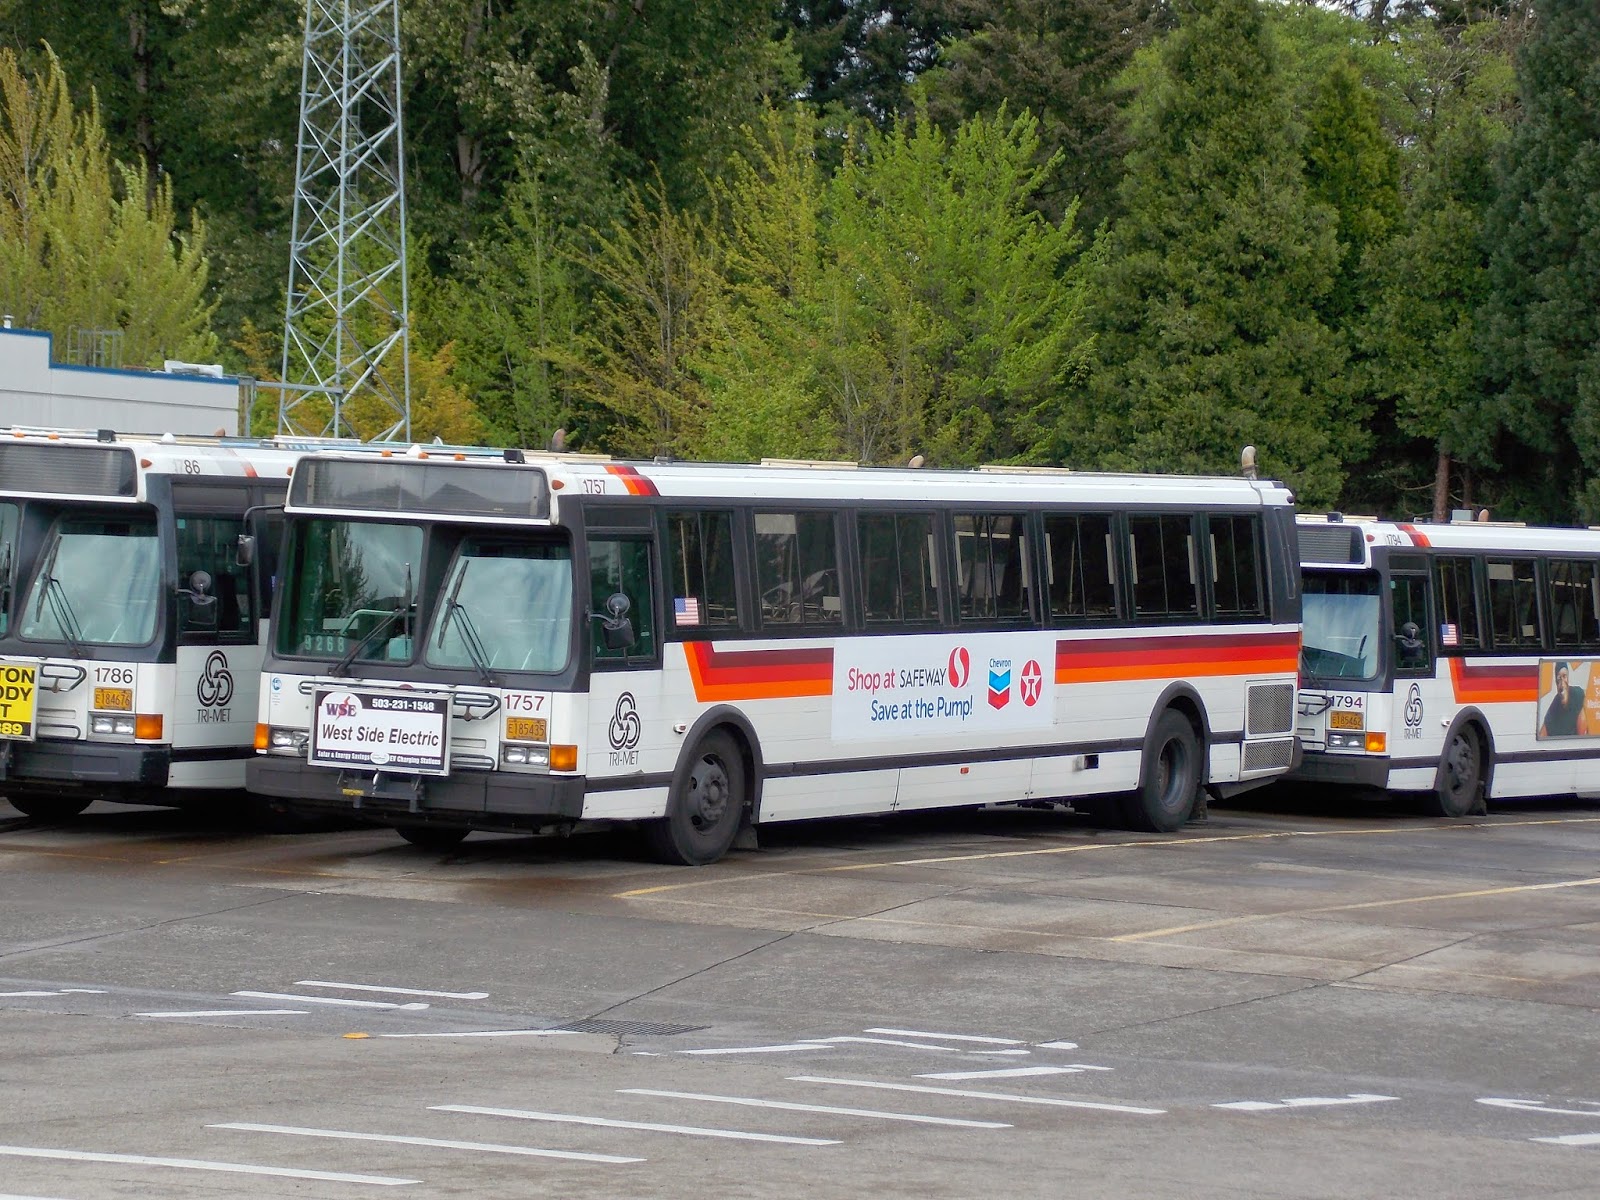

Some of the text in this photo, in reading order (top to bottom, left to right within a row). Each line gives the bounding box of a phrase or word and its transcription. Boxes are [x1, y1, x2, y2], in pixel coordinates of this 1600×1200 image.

[583, 479, 606, 494] 1757
[304, 634, 345, 652] 9268
[989, 658, 1012, 669] Chevron
[94, 667, 133, 684] 1786
[848, 667, 948, 695] Shop at SAFEWAY
[0, 685, 32, 702] DY
[372, 698, 435, 711] 503-231-1548
[504, 694, 545, 711] 1757
[871, 695, 974, 722] Save at the Pump!
[1330, 695, 1363, 708] 1794
[197, 708, 231, 723] TRI-MET
[325, 702, 357, 718] WSE
[0, 722, 23, 735] 89
[322, 723, 439, 747] West Side Electric
[508, 722, 545, 737] E185435
[1403, 727, 1422, 739] TRI-MET
[397, 755, 420, 764] Charging
[608, 750, 640, 766] TRI-MET
